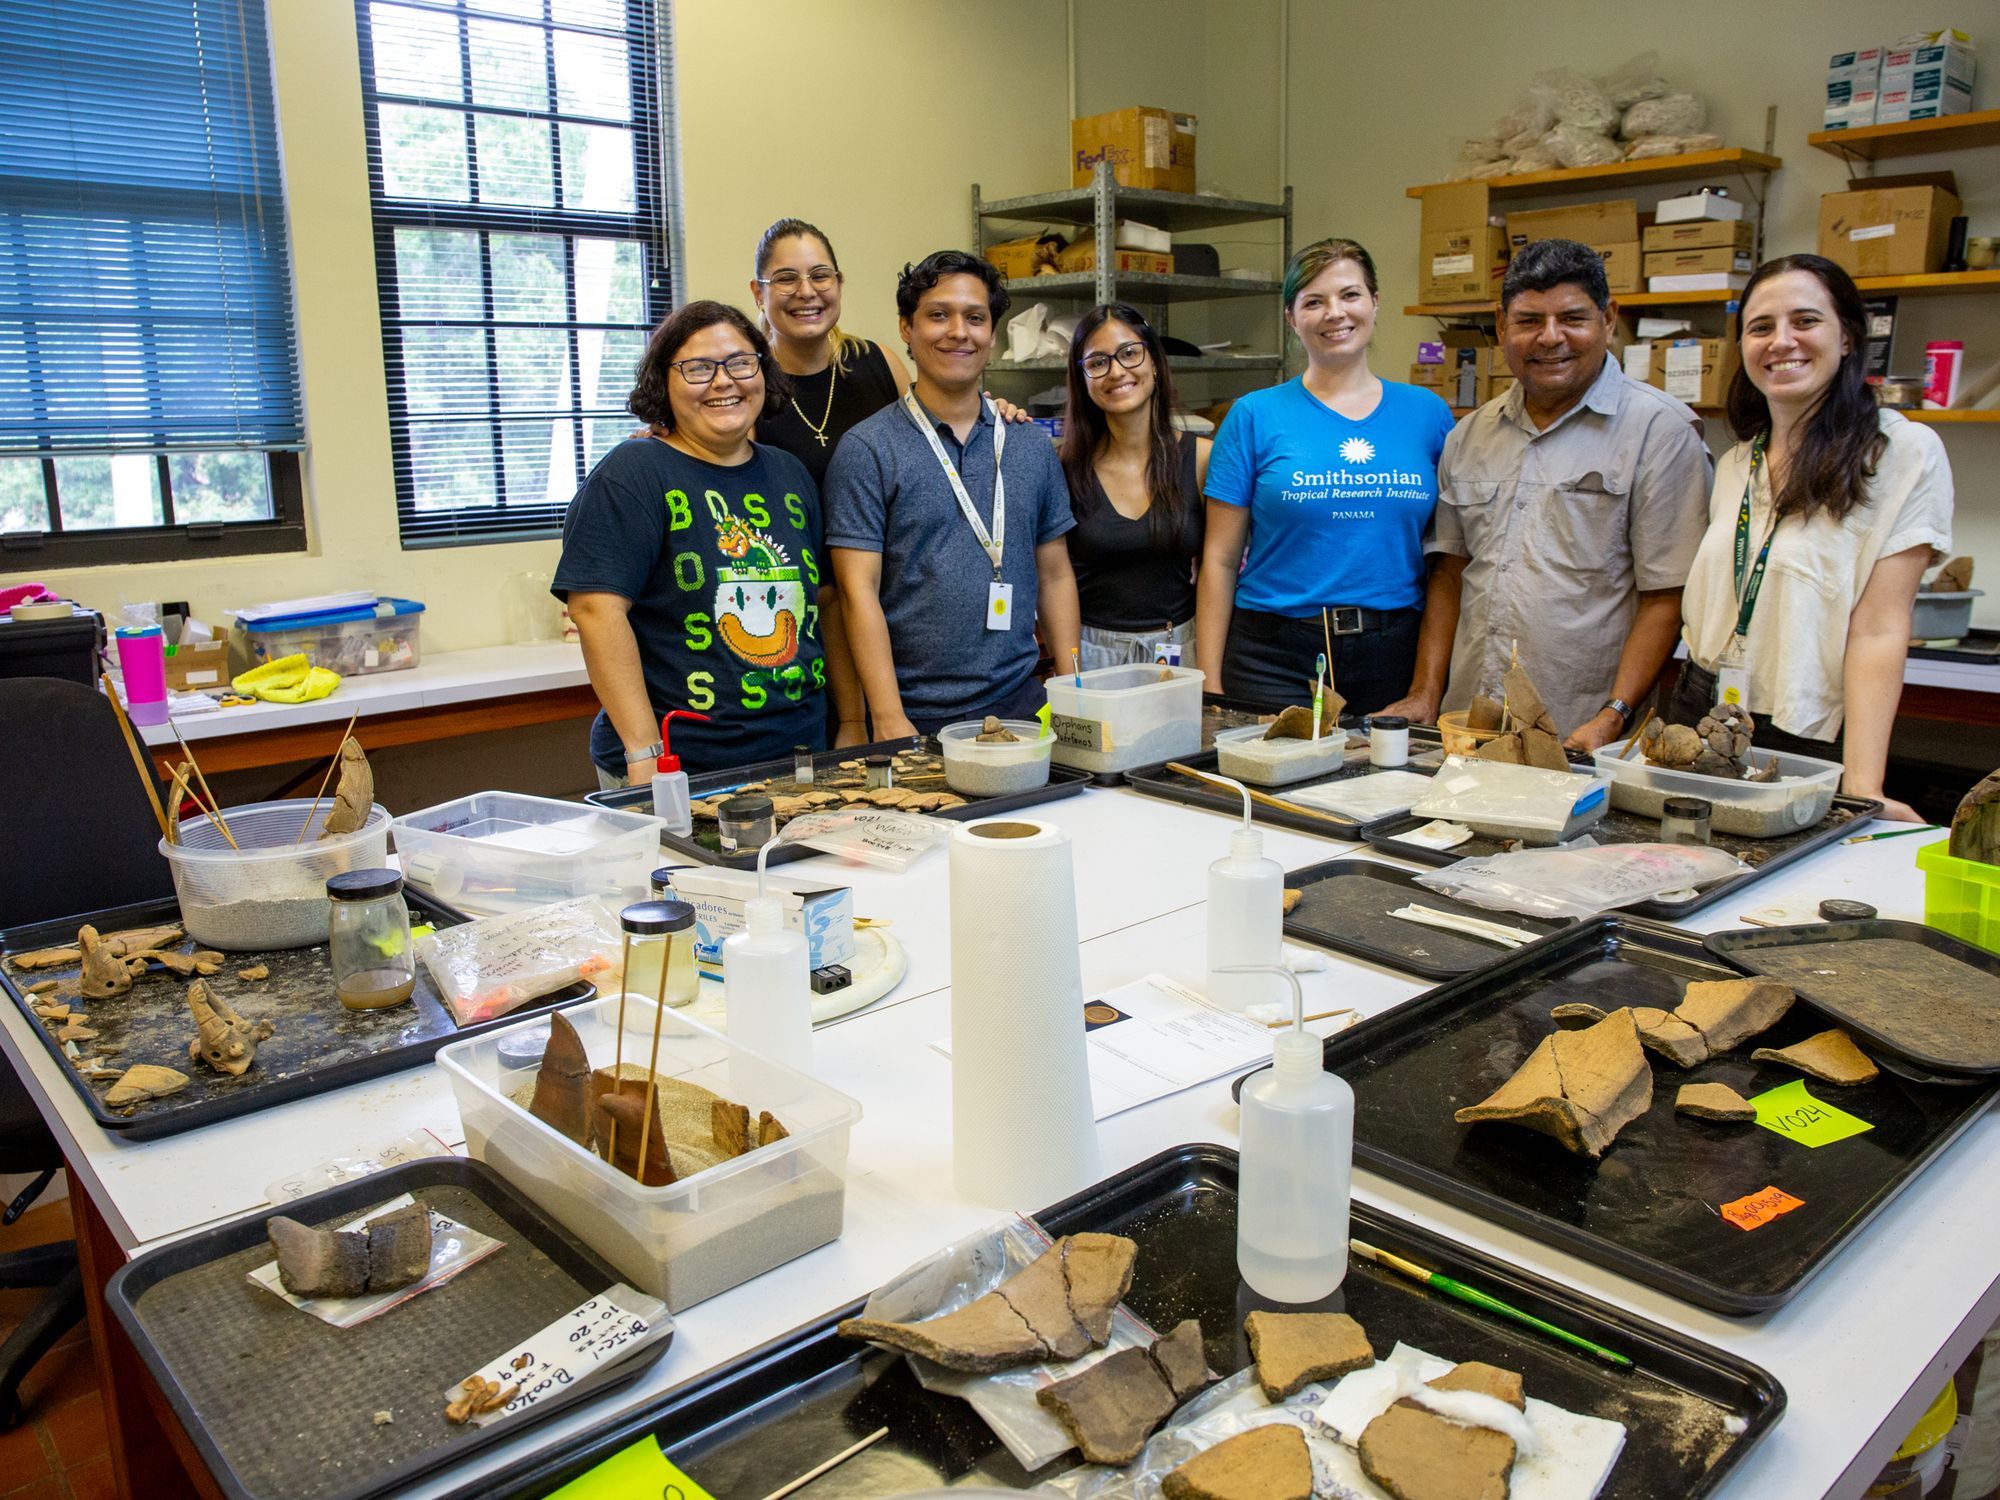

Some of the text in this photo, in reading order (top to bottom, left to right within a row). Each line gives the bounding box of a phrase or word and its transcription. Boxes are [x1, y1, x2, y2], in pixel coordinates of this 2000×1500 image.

[1291, 469, 1423, 487] Smithsonian
[1281, 487, 1430, 503] Tropical Research Institute
[1332, 511, 1375, 520] PANAMA
[1052, 715, 1093, 735] Orphans
[1765, 1104, 1833, 1133] V024
